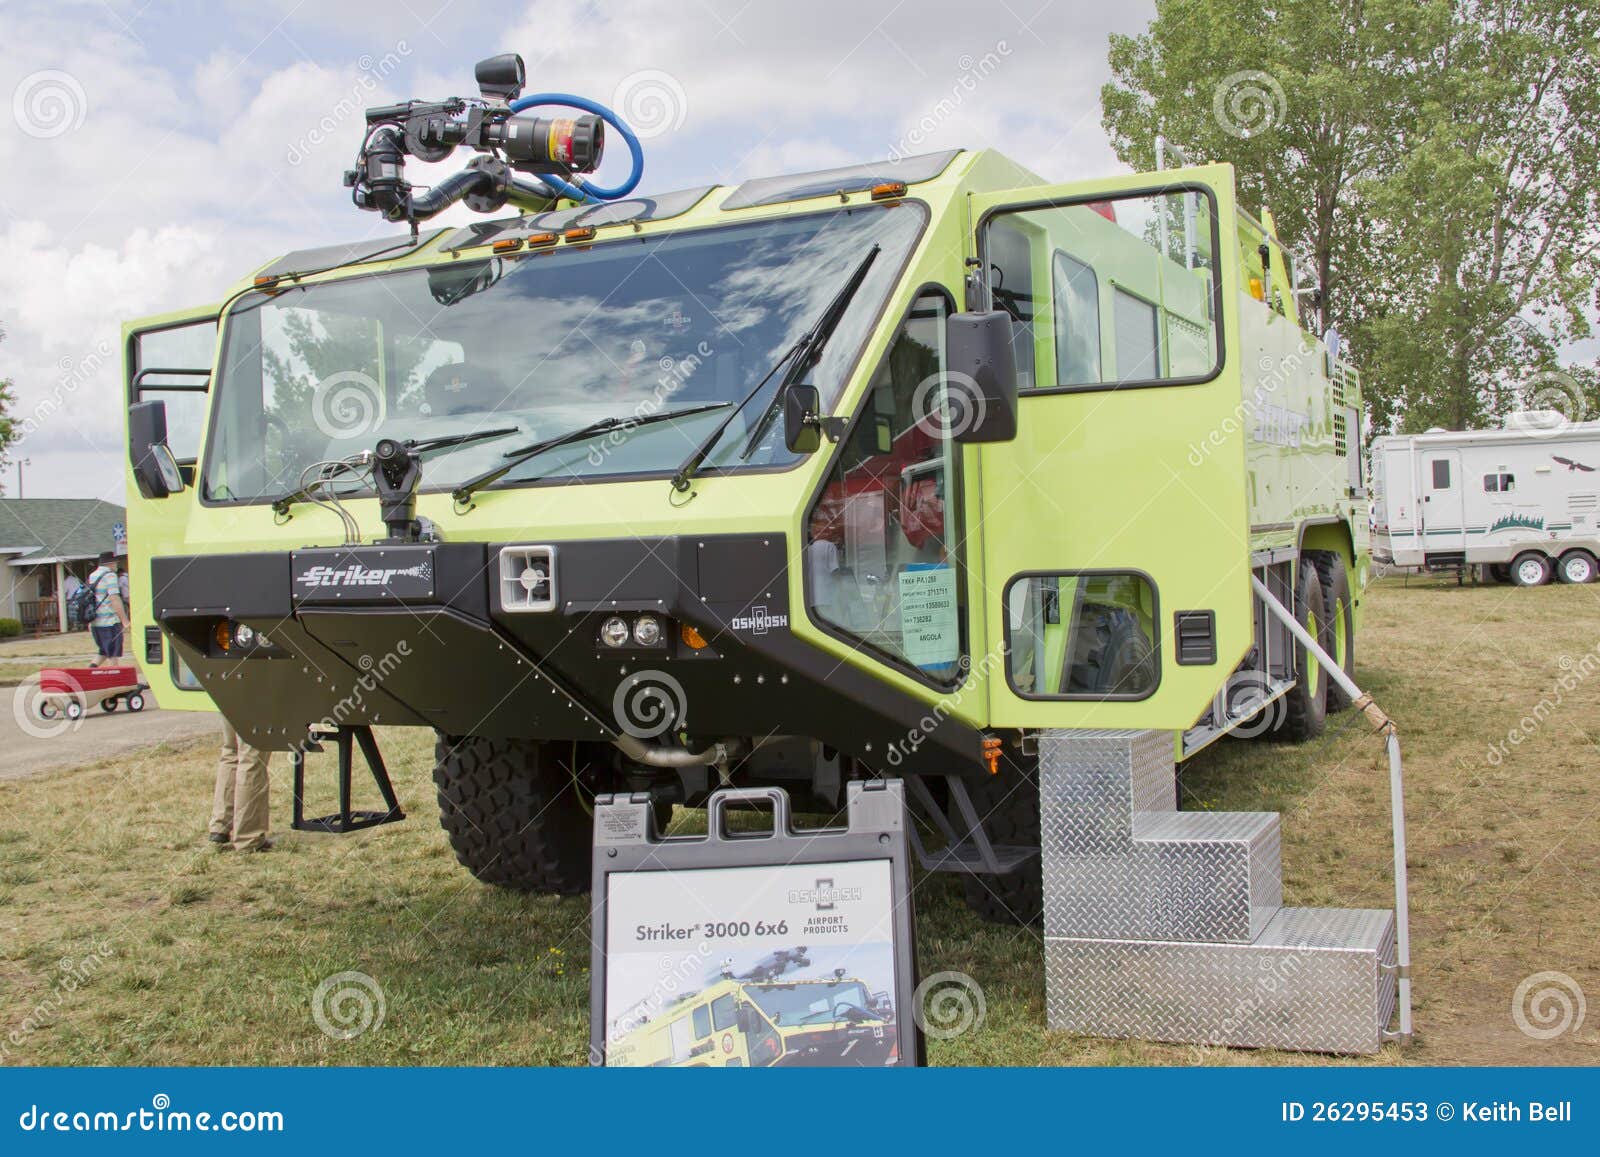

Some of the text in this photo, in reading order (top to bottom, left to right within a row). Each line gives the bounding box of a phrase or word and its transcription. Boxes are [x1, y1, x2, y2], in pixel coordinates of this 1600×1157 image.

[296, 564, 397, 587] Striker
[732, 615, 788, 630] OSHKOSH
[788, 886, 864, 905] OSHKOSH
[704, 921, 750, 939] 3000
[754, 920, 789, 937] 6x6
[807, 916, 845, 926] AIRPORT
[803, 925, 849, 935] PRODUCTS
